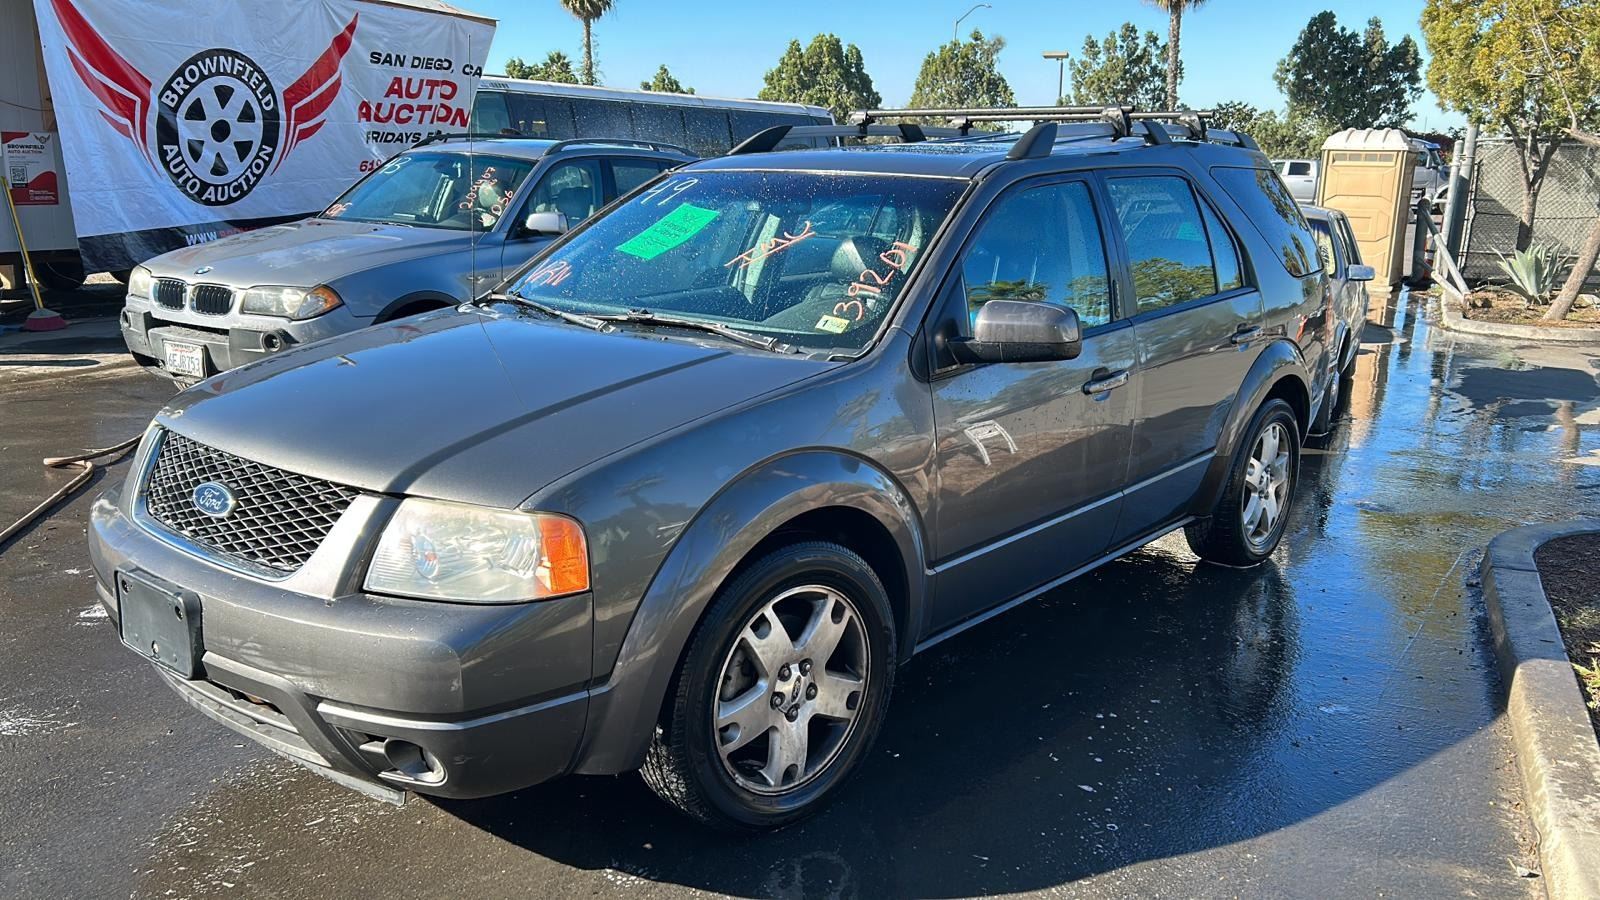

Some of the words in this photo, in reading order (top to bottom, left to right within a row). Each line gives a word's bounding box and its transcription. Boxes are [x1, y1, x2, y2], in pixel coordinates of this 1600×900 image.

[370, 51, 406, 68] SAN
[411, 56, 454, 73] DIEGO,
[462, 63, 483, 79] CA
[161, 55, 274, 111] BROWNFIELD
[384, 76, 458, 101] AUTO
[358, 100, 471, 128] AUCTION
[367, 131, 421, 144] FRIDAYS
[163, 144, 200, 194] AUTO
[201, 144, 273, 202] AUCTION
[200, 487, 225, 511] Ford
